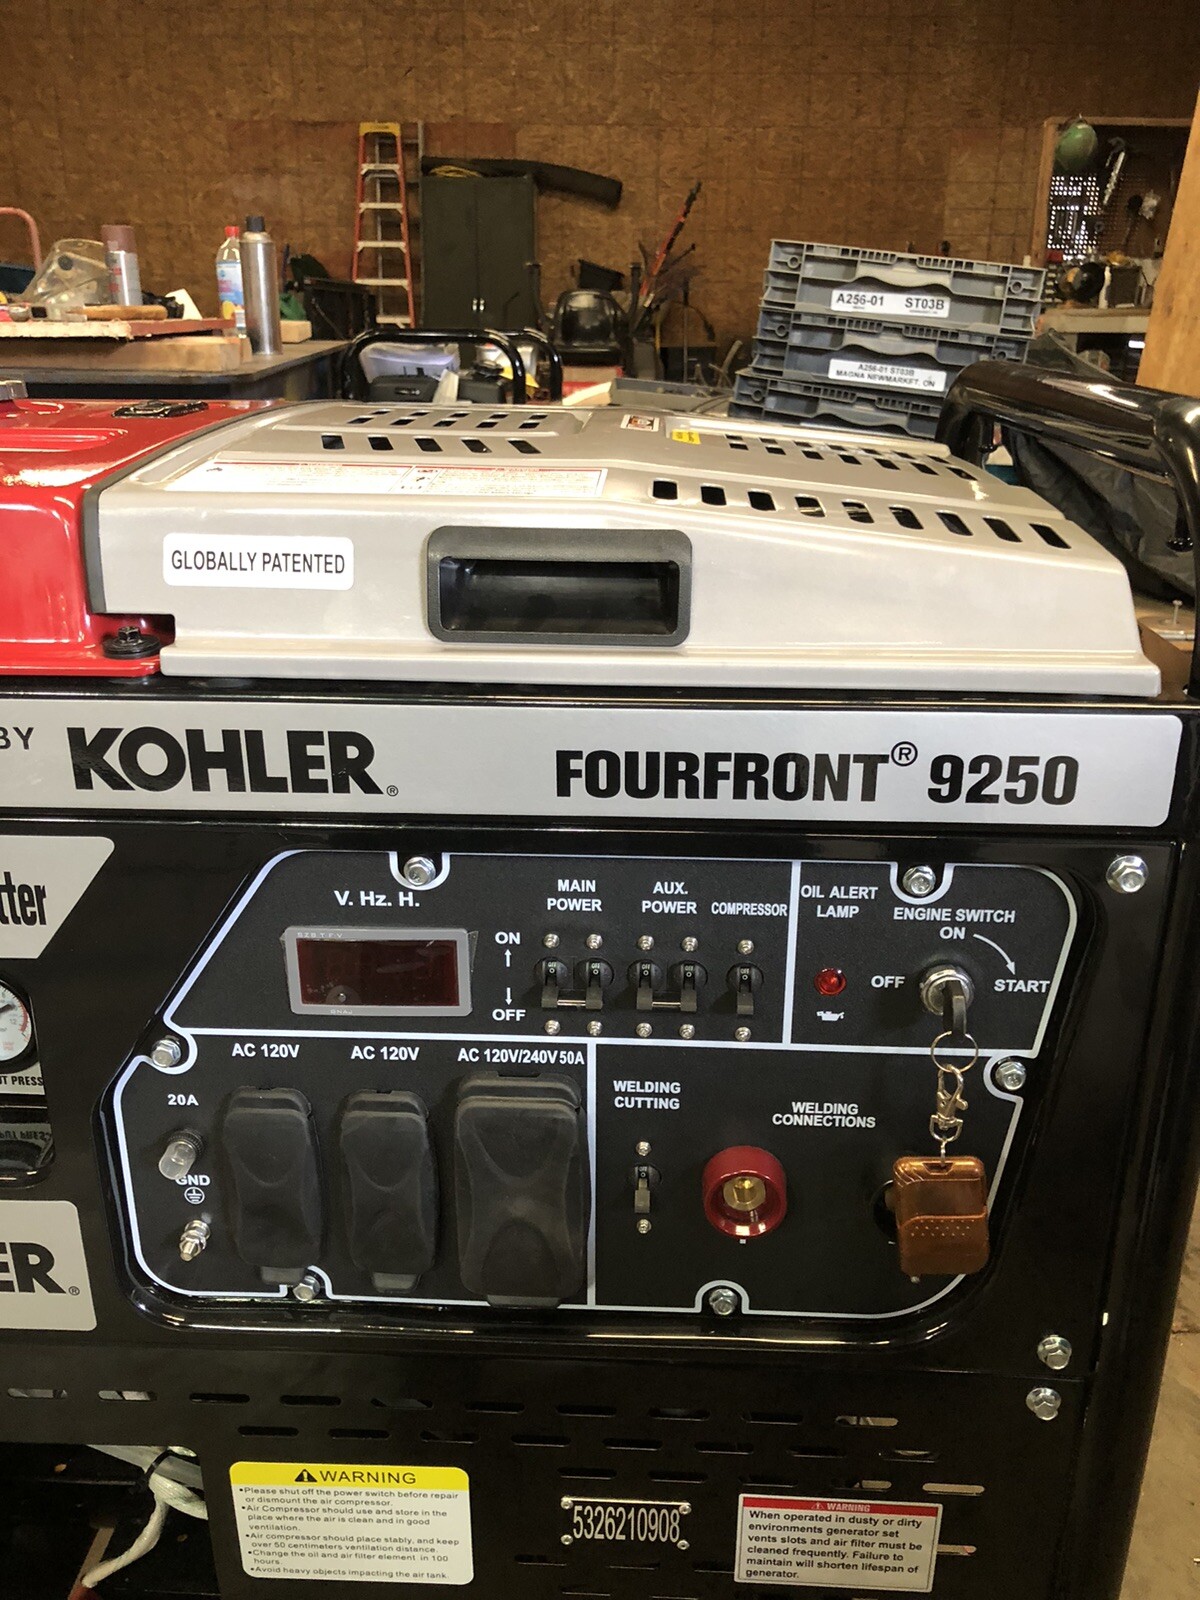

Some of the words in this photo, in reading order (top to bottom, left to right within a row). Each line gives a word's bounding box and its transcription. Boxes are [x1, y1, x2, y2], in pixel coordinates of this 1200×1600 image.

[836, 293, 884, 306] A256-01
[905, 297, 945, 310] ST03B
[171, 550, 257, 571] GLOBALLY
[262, 552, 345, 574] PATENTED
[66, 726, 384, 795] KOHLER
[555, 750, 890, 801] FOURFRONT
[927, 755, 1079, 806] 9250
[557, 880, 596, 893] MAIN
[652, 881, 688, 895] AUX.
[800, 885, 825, 898] OIL
[829, 886, 878, 900] ALERT
[333, 890, 353, 906] V.
[359, 890, 392, 906] Hz.
[398, 891, 420, 907] H.
[546, 898, 602, 912] POWER
[641, 900, 697, 915] POWER
[711, 902, 788, 917] COMPRESSOR
[816, 905, 859, 918] LAMP
[893, 907, 952, 922] ENGINE
[955, 908, 1015, 923] SWITCH
[495, 932, 521, 945] ON
[939, 926, 966, 940] ON
[871, 976, 905, 989] OFF
[994, 979, 1050, 993] START
[492, 1008, 526, 1021] OFF
[231, 1043, 256, 1057] AC
[261, 1044, 299, 1058] 120V
[351, 1046, 375, 1060] AC
[380, 1046, 419, 1061] 120V
[457, 1048, 479, 1062] AC
[483, 1048, 558, 1064] 120V/240V
[559, 1050, 585, 1065] 50A
[11, 1076, 44, 1086] PRESS
[613, 1080, 681, 1094] WELDING
[167, 1093, 199, 1106] 20A
[614, 1096, 680, 1110] CUTTING
[791, 1101, 859, 1115] WELDING
[772, 1114, 876, 1128] CONNECTIONS
[175, 1174, 211, 1186] GND
[320, 1471, 416, 1484] WARNING
[430, 1492, 459, 1500] repair
[262, 1505, 320, 1513] Compressor
[826, 1502, 871, 1512] WARNING
[573, 1505, 680, 1543] 5326210908
[749, 1510, 780, 1519] When
[783, 1514, 832, 1522] operated
[835, 1515, 845, 1523] in
[848, 1516, 879, 1526] dusty
[897, 1518, 922, 1529] dirty
[748, 1523, 823, 1534] environments
[826, 1528, 879, 1536] generator
[882, 1530, 899, 1538] set
[288, 1542, 343, 1550] centimeters
[436, 1538, 459, 1546] keep
[748, 1535, 777, 1543] vents
[780, 1536, 807, 1544] slots
[810, 1538, 830, 1546] and
[850, 1539, 876, 1548] filter
[878, 1542, 906, 1550] must
[909, 1542, 922, 1550] be
[252, 1549, 289, 1558] Change
[378, 1553, 416, 1561] element
[747, 1546, 789, 1555] cleaned
[792, 1548, 849, 1560] frequently.
[852, 1550, 890, 1560] Failure
[746, 1557, 792, 1567] maintain
[795, 1560, 814, 1568] will
[817, 1561, 858, 1570] shorten
[861, 1563, 904, 1573] lifespan
[283, 1567, 311, 1575] heavy
[312, 1568, 346, 1576] objects
[348, 1570, 393, 1578] impacting
[746, 1569, 799, 1578] generator.
